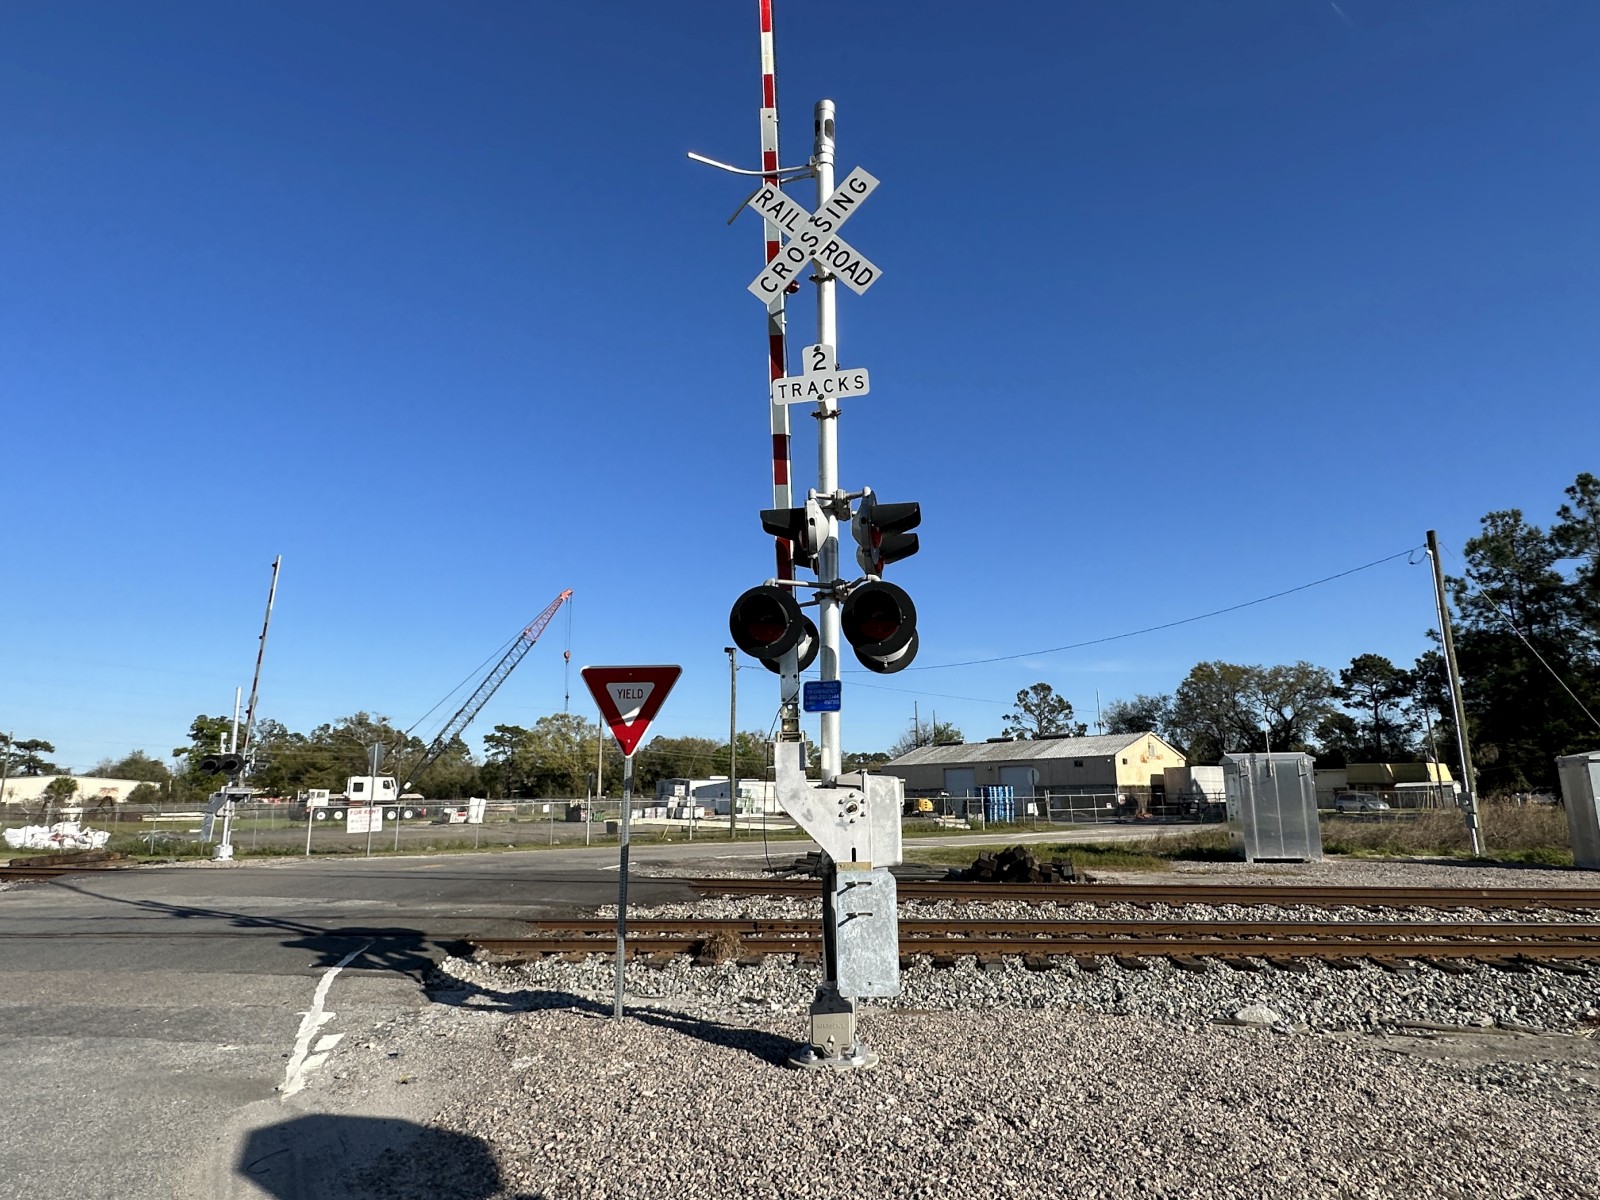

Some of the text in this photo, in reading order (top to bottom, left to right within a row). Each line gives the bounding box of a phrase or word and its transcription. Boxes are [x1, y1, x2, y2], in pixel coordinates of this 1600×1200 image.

[755, 189, 874, 287] RAIL ROAD
[760, 177, 867, 293] CROSSING
[812, 352, 826, 371] 2
[778, 375, 865, 399] TRACKS
[617, 688, 643, 699] YIELD
